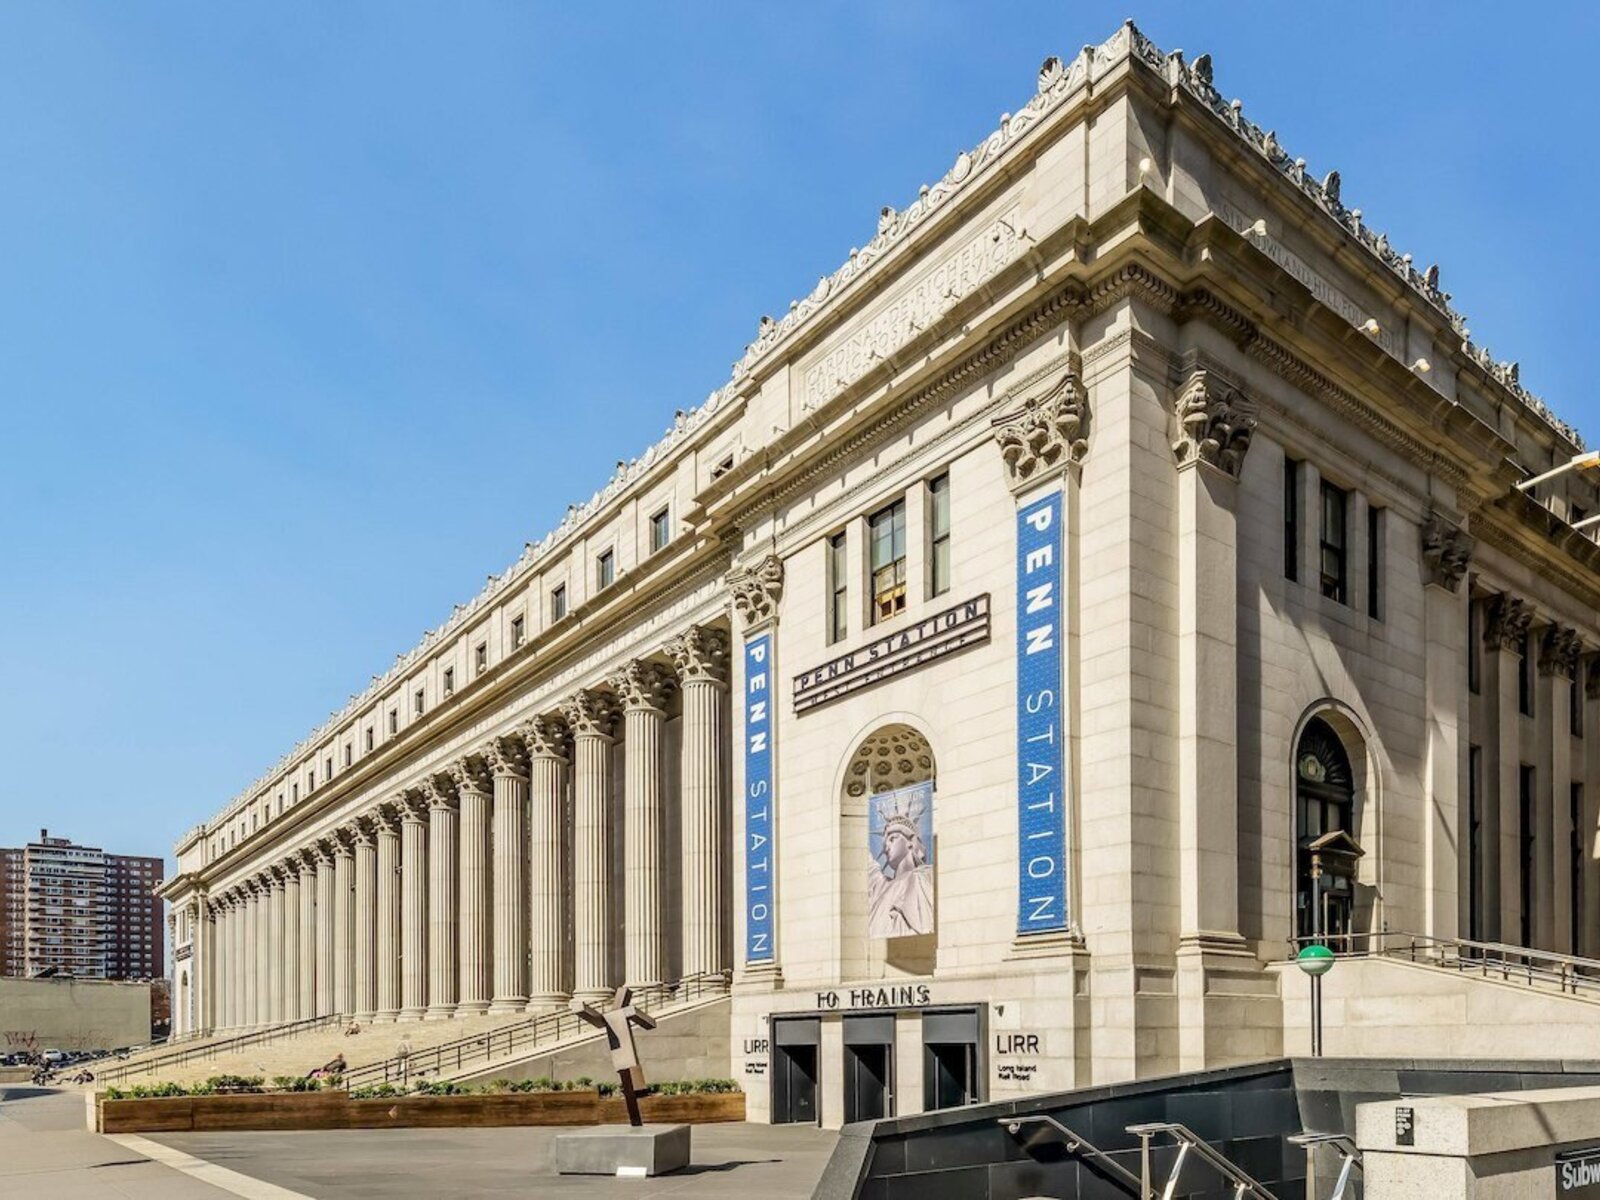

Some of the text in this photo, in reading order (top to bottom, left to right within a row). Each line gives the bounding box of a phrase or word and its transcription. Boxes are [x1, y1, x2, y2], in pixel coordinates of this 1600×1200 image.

[1314, 277, 1341, 311] HILL
[801, 602, 977, 690] PENN STATION
[1027, 504, 1054, 922] PENN STATION
[750, 644, 767, 953] PENN STATION
[816, 984, 930, 1009] TO TRAINS
[744, 1040, 769, 1054] LIRR
[997, 1034, 1039, 1054] LIRR
[998, 1064, 1014, 1074] Long
